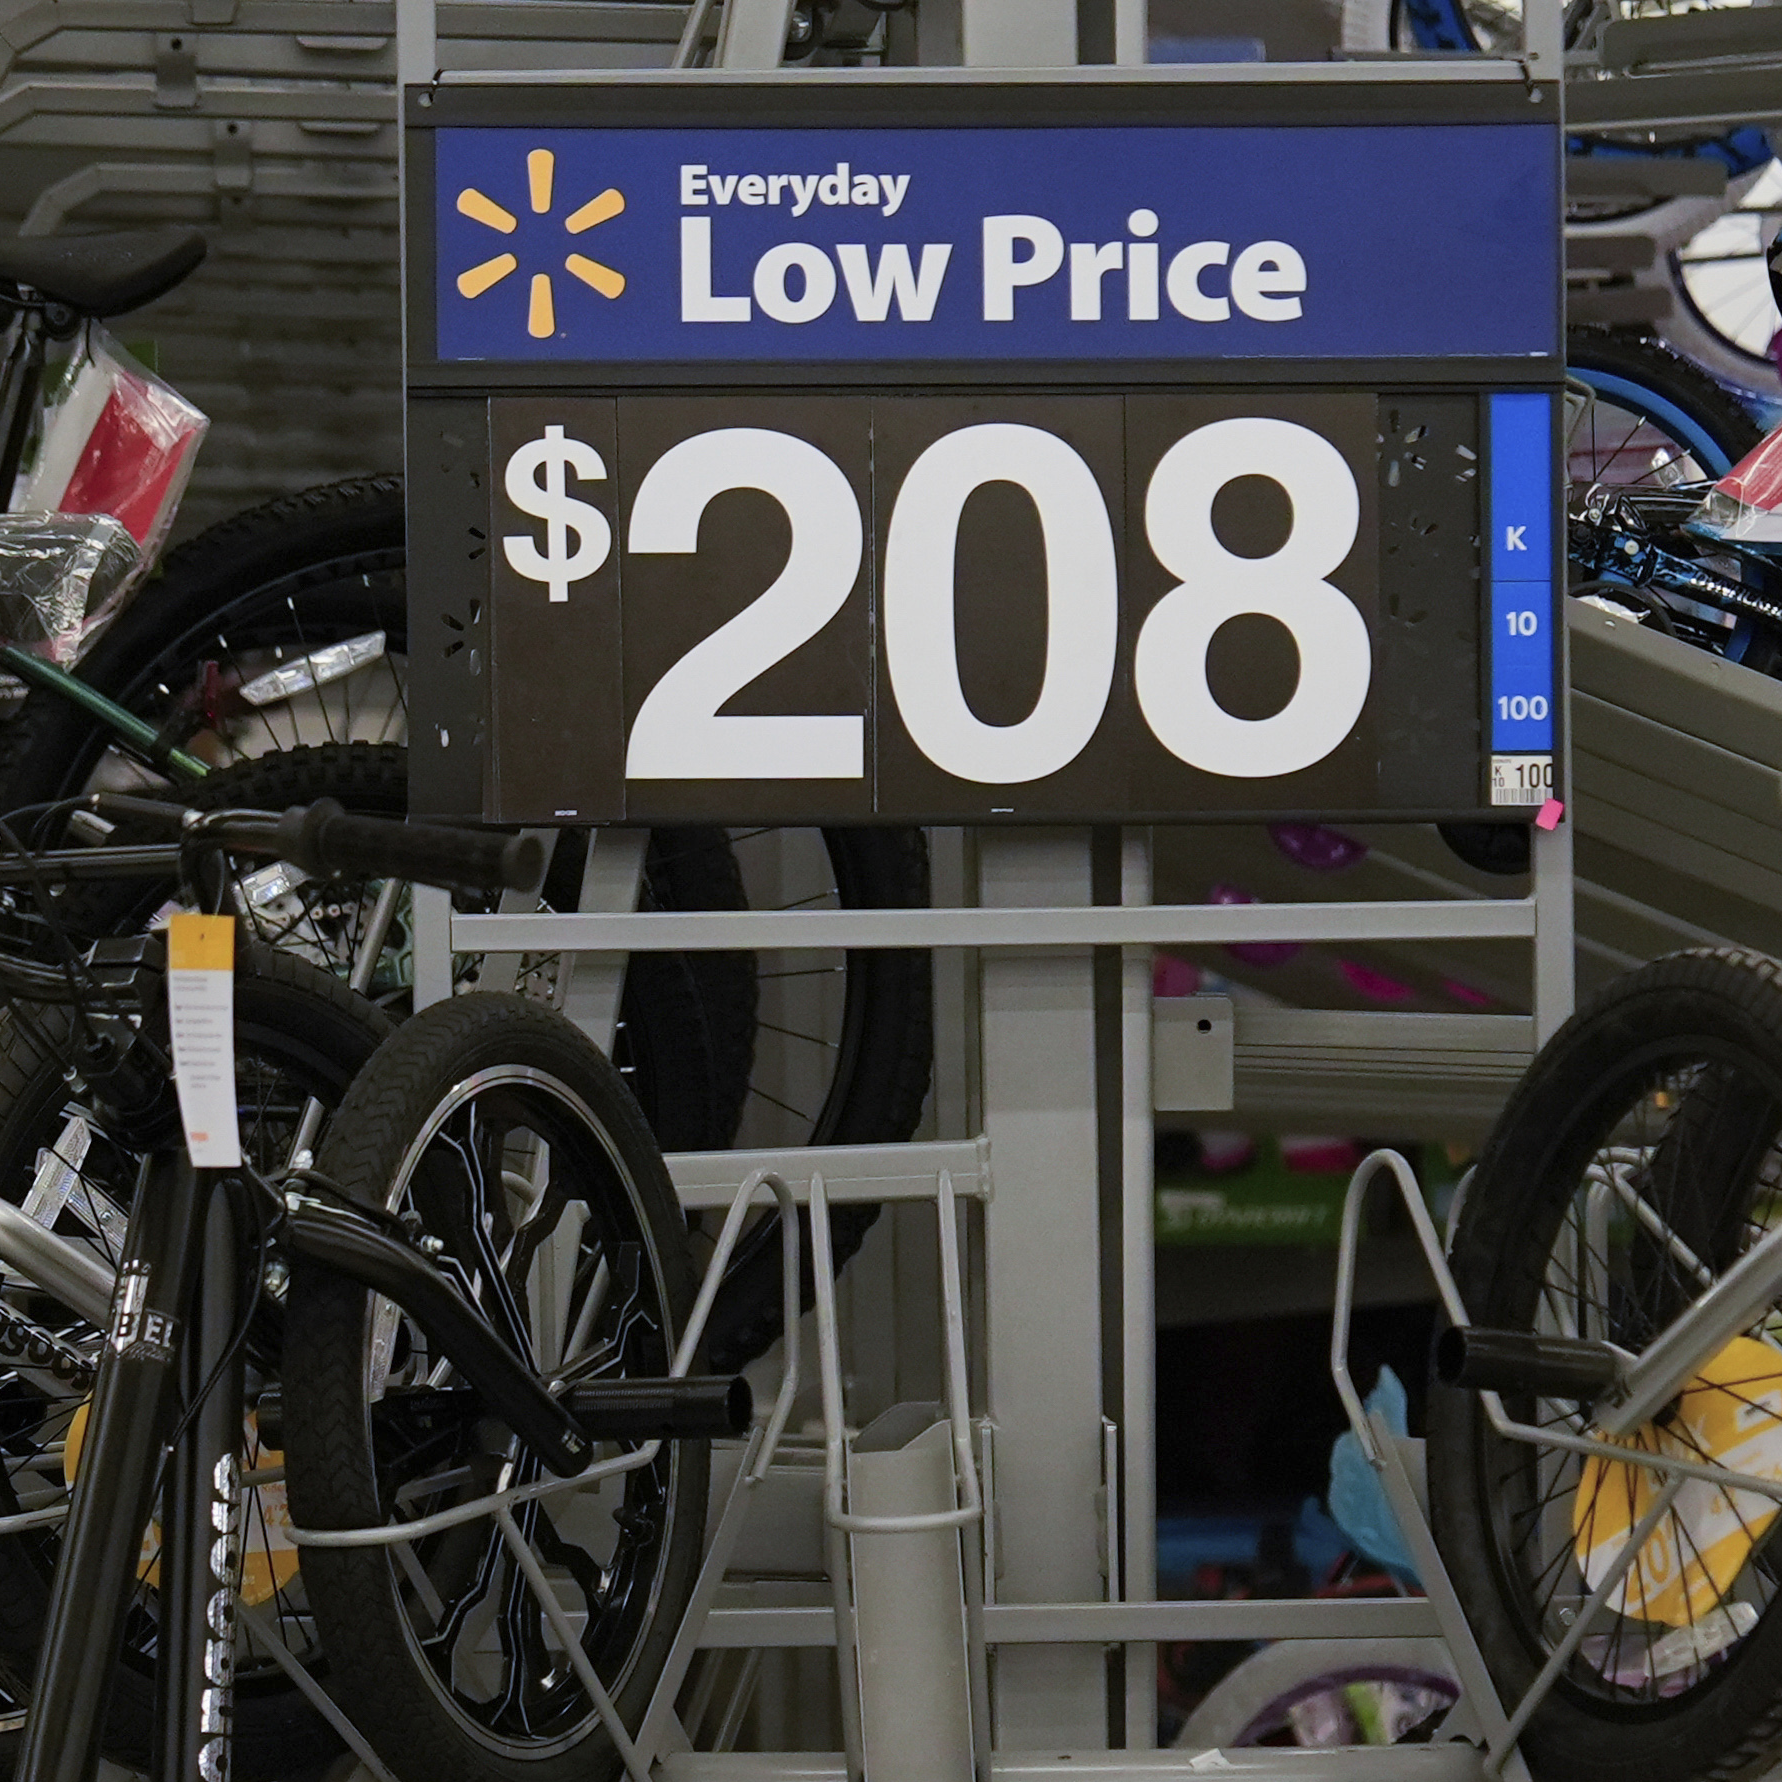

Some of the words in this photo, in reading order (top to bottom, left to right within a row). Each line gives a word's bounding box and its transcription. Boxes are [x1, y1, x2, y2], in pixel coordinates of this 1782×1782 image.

[679, 162, 910, 216] Everyday
[680, 214, 953, 324] Low
[983, 208, 1308, 324] Price
[1506, 526, 1527, 550] K
[1505, 611, 1537, 636] 10
[1497, 696, 1548, 720] 100
[1495, 766, 1502, 776] K
